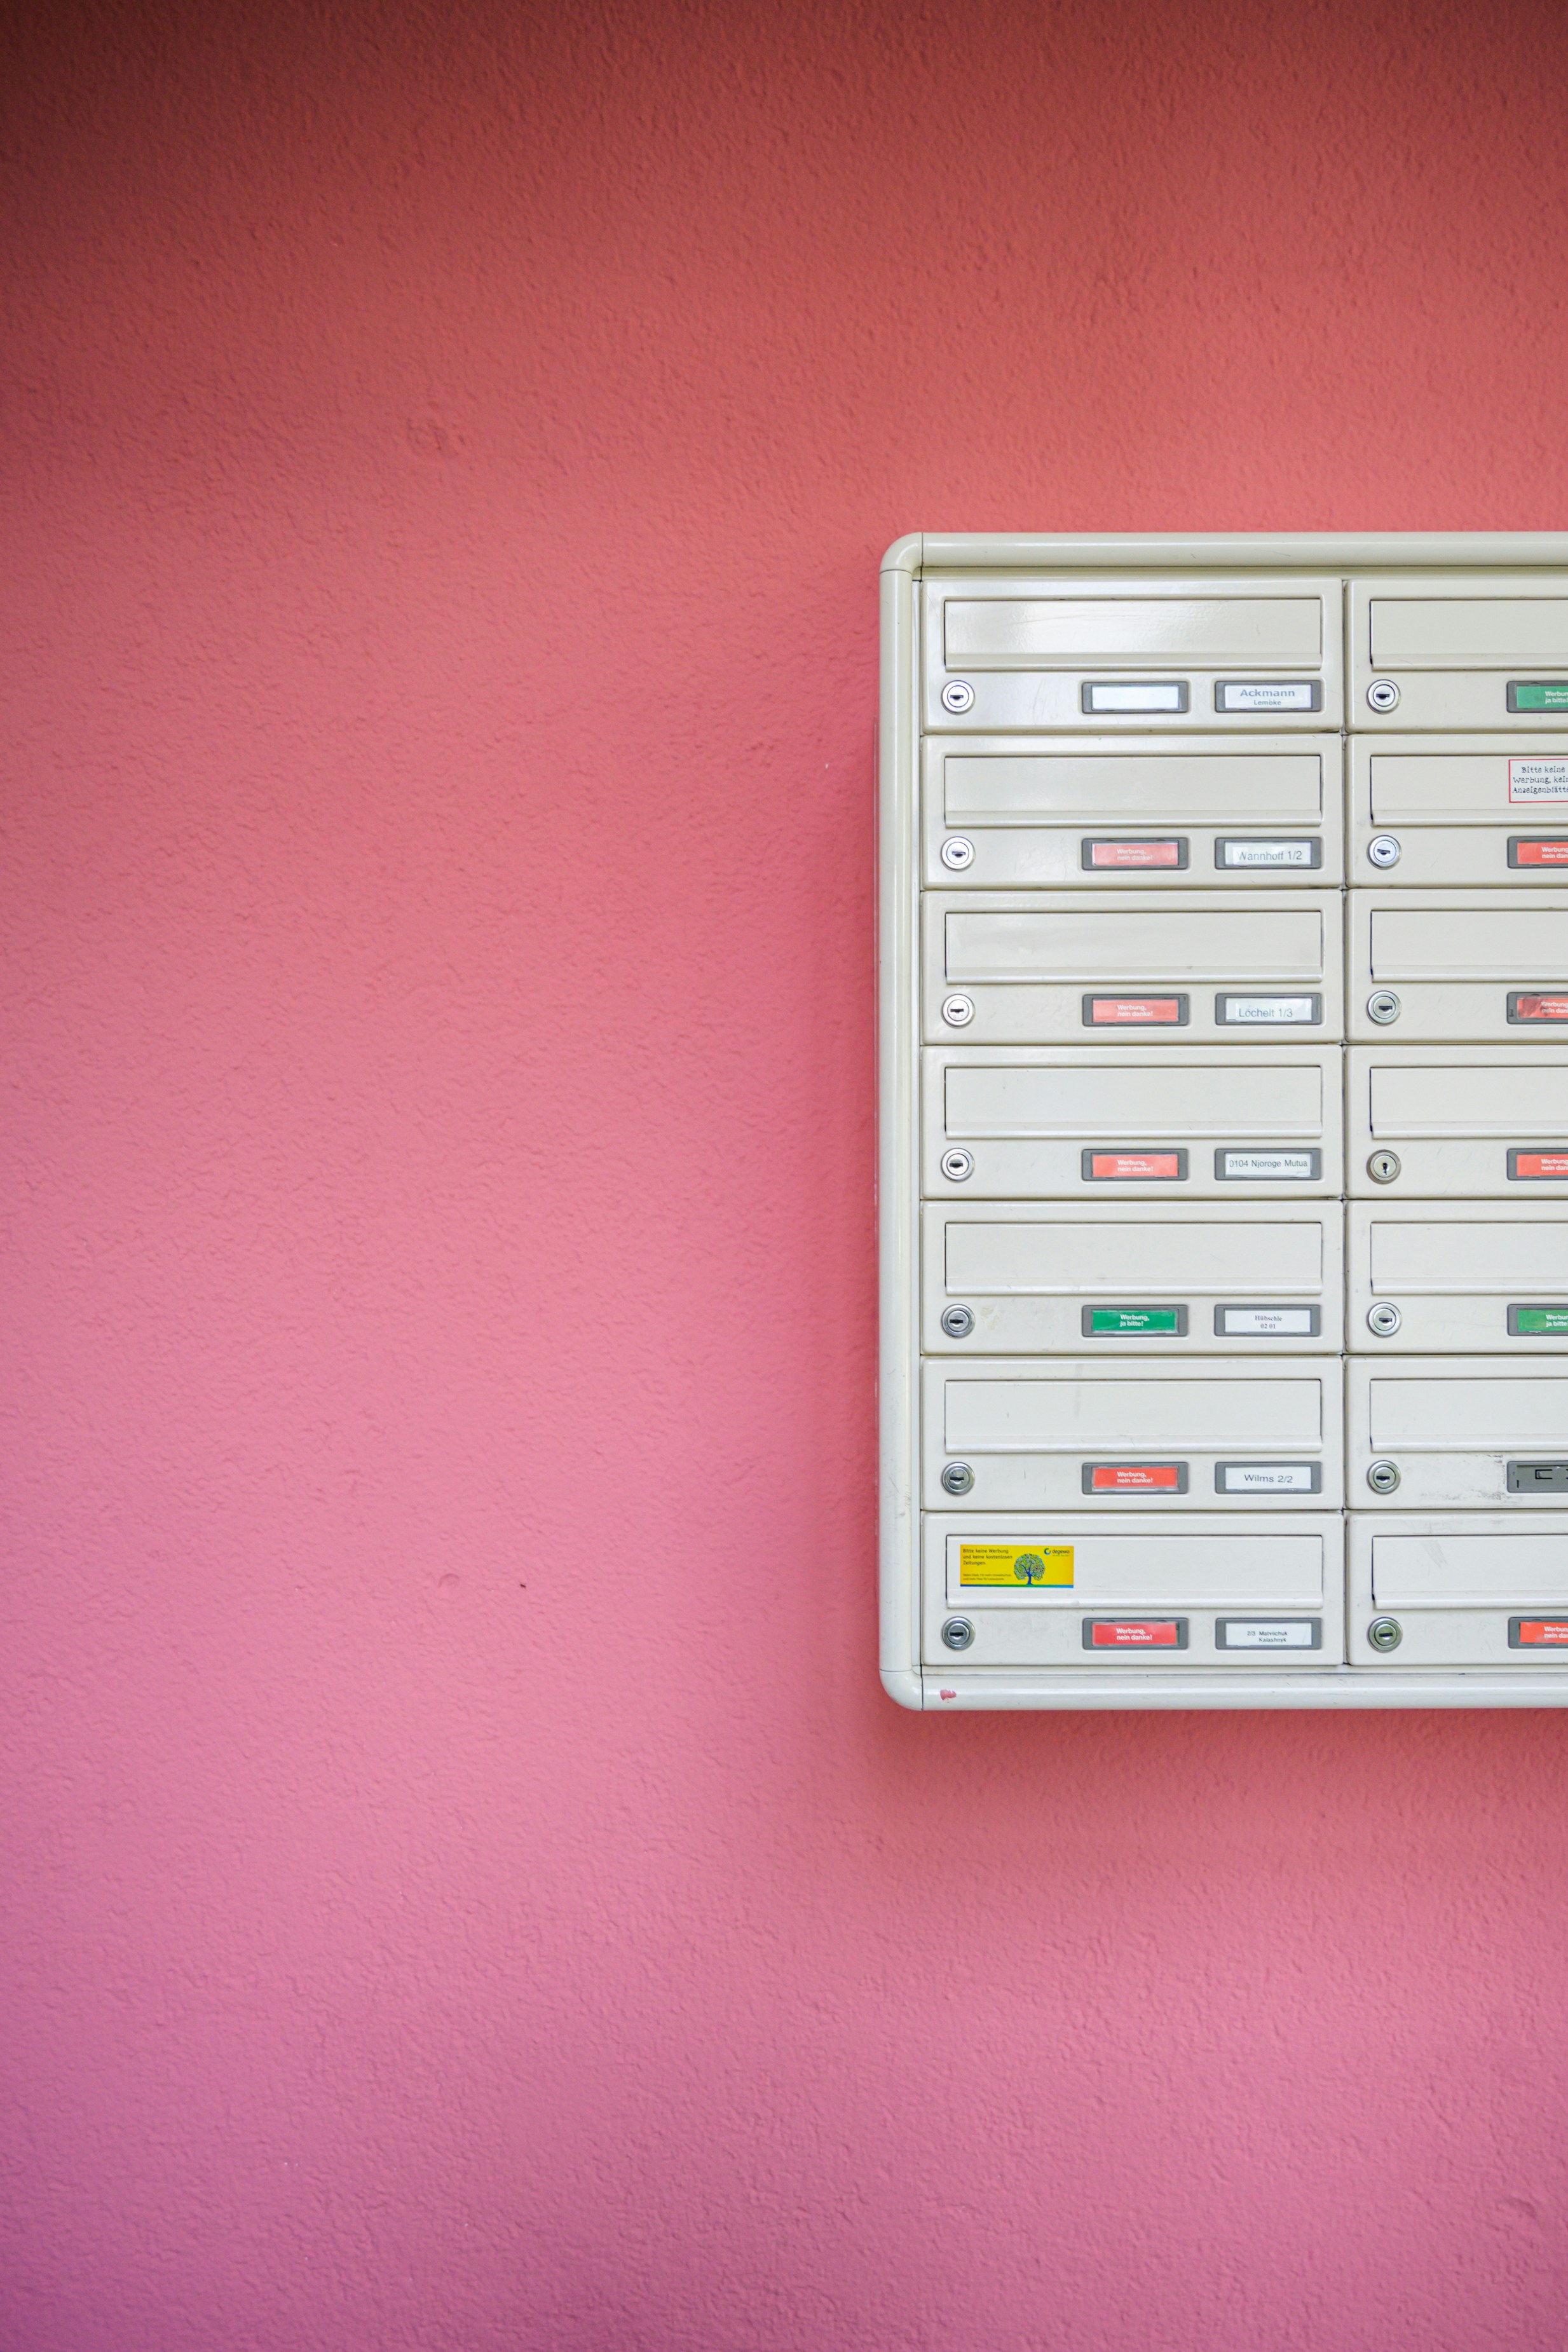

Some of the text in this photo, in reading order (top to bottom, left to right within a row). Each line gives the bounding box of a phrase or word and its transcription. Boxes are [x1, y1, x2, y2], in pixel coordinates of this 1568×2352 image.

[1237, 851, 1302, 860] Wannhoff 1/2
[1239, 1008, 1293, 1017] Löchelt 1/3
[1251, 1159, 1281, 1168] Njoroge
[1244, 1474, 1274, 1482] Wilms
